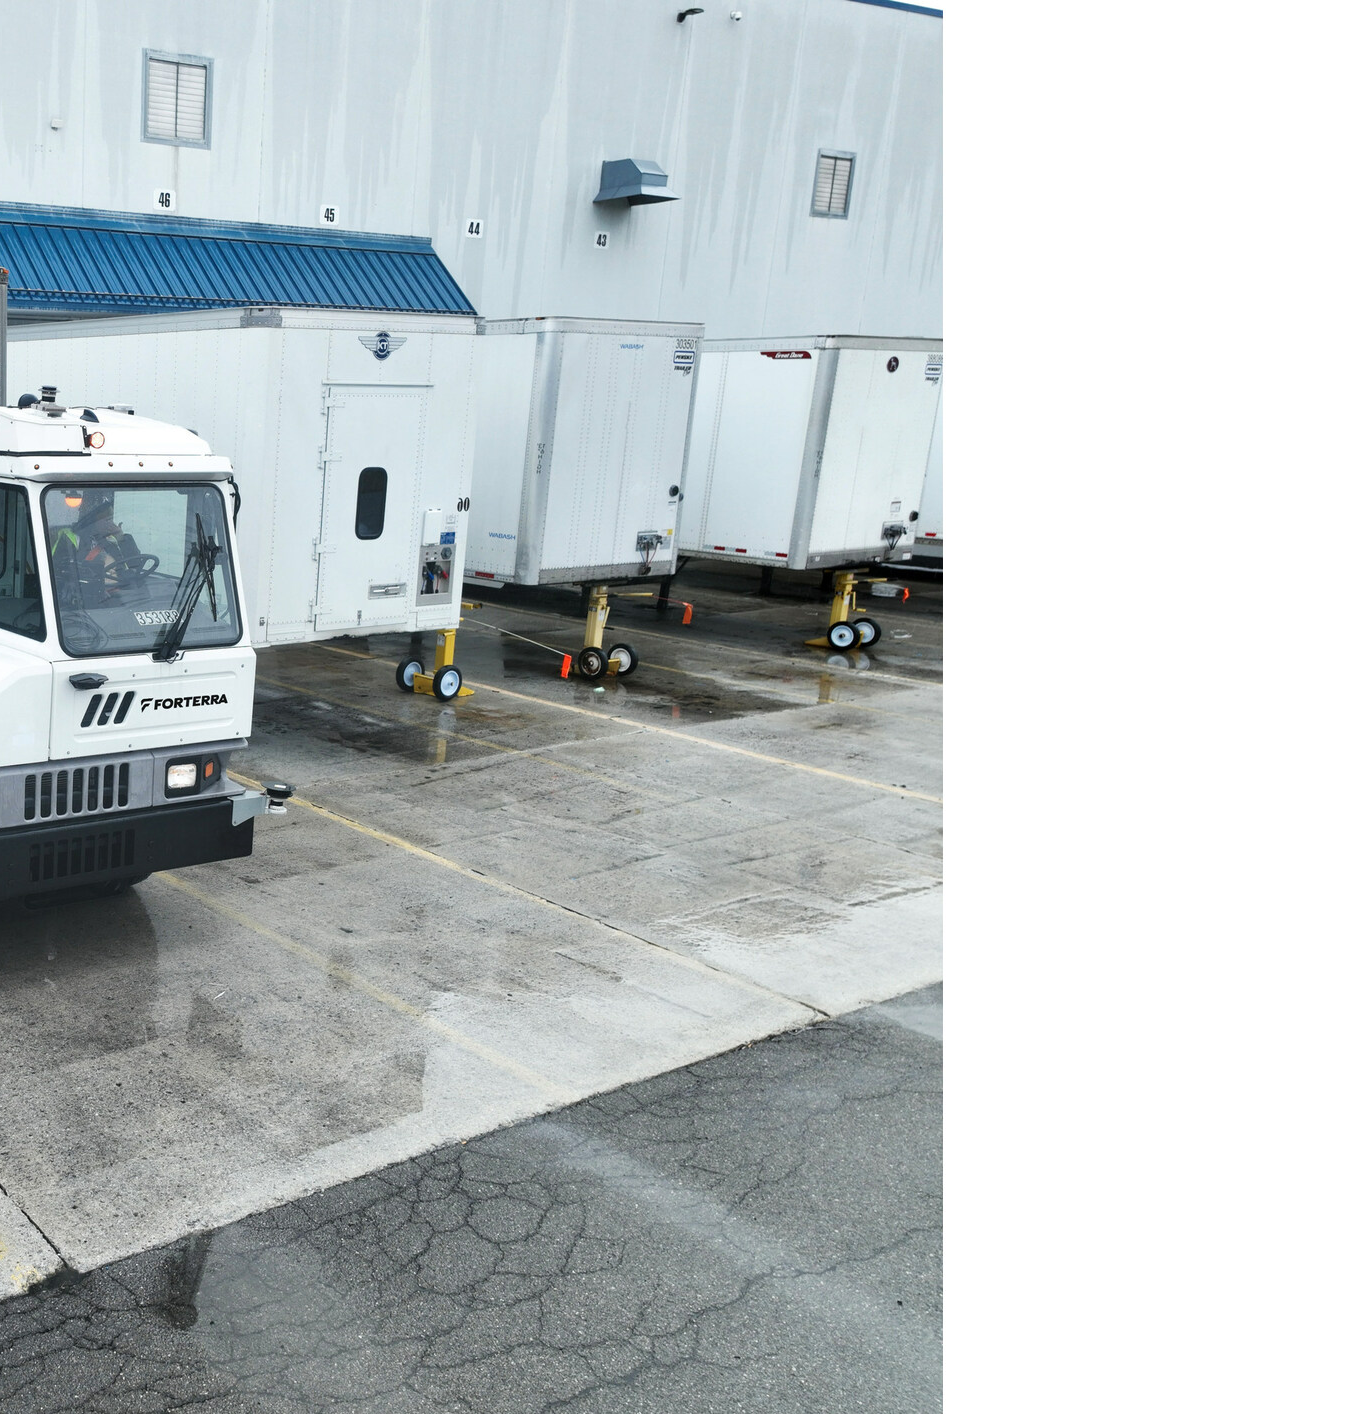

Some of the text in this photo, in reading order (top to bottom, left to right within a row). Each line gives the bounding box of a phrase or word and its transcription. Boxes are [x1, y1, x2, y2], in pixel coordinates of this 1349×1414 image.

[158, 192, 171, 208] 46
[324, 207, 335, 222] 45
[468, 221, 480, 235] 44
[596, 233, 607, 247] 43
[489, 531, 516, 540] WABASH
[153, 693, 228, 710] FORTERRA
